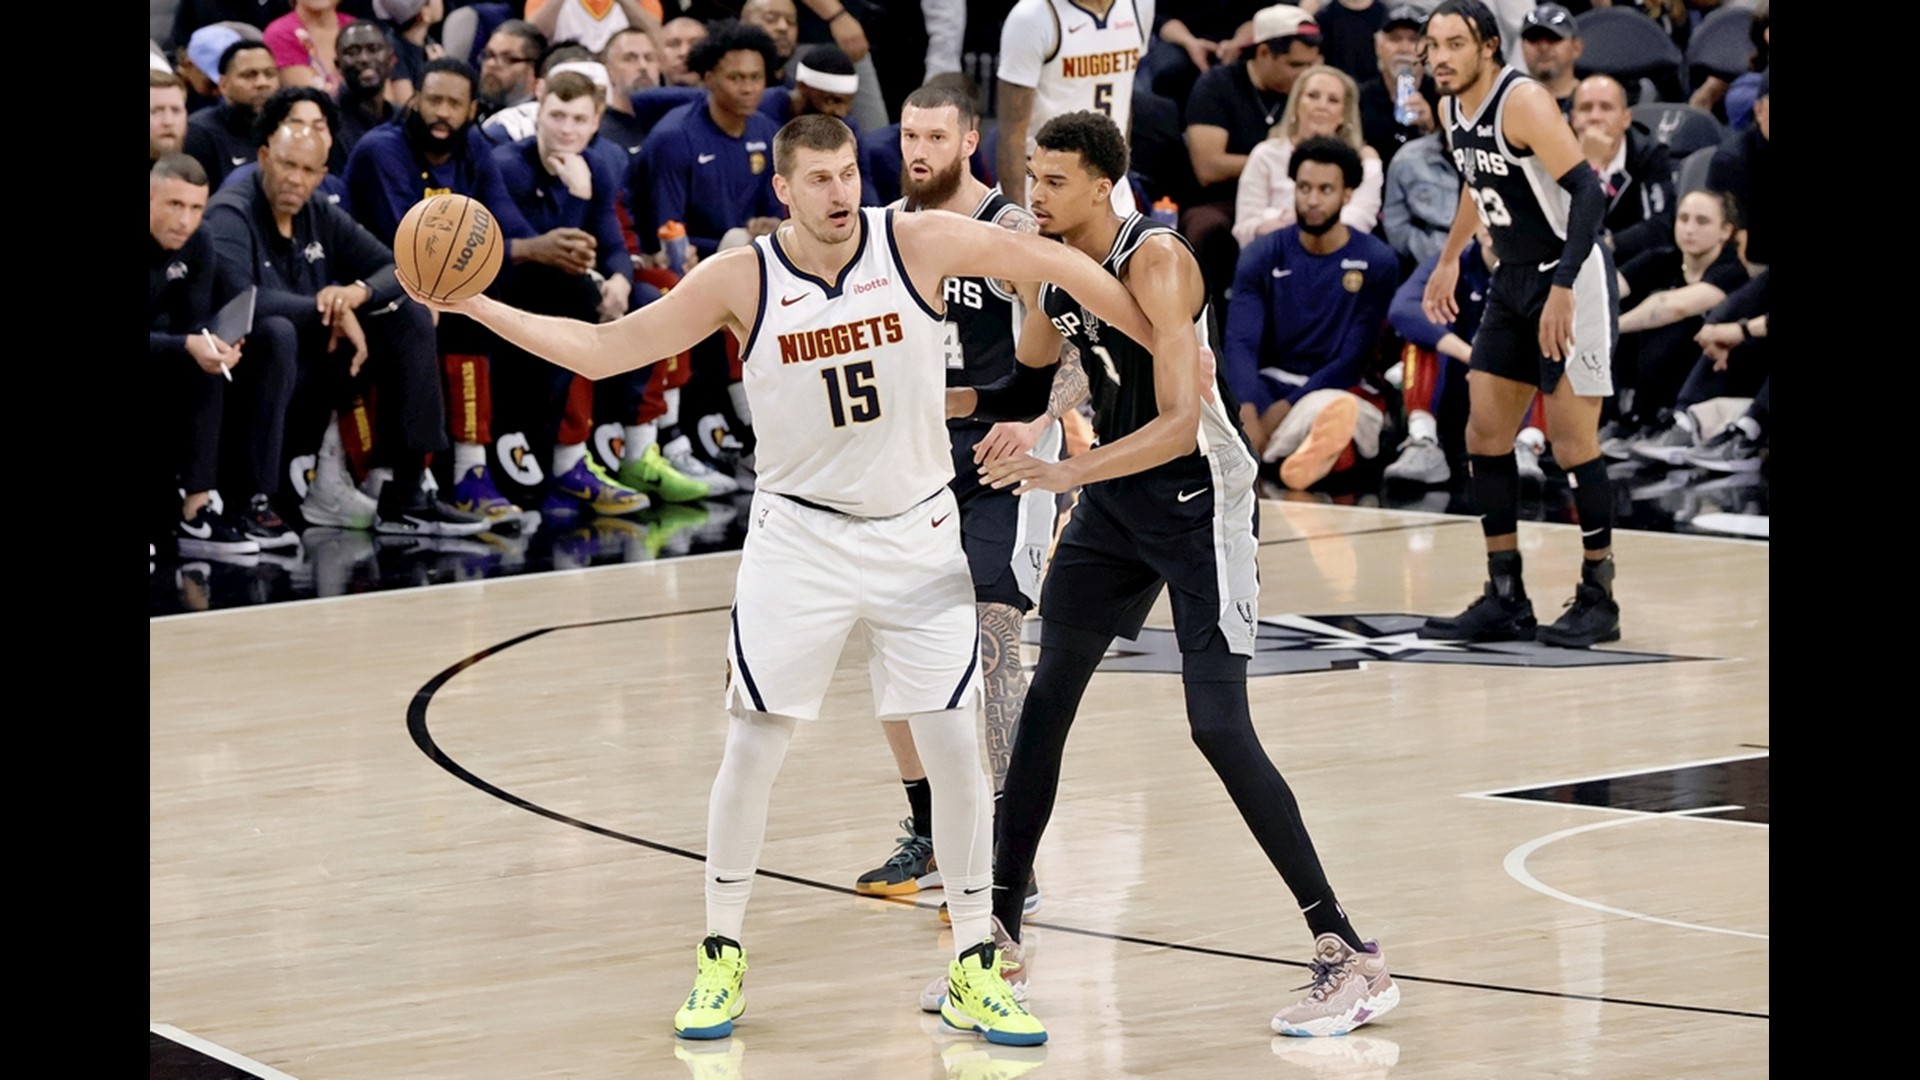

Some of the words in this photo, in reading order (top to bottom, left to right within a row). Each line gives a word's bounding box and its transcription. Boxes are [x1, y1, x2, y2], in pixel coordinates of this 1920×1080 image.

[1094, 83, 1113, 118] 5
[452, 208, 490, 273] Wilson
[853, 276, 889, 295] ibotta
[777, 312, 904, 364] NUGGETS
[944, 320, 965, 369] 4
[821, 360, 882, 428] 15
[496, 431, 545, 486] G
